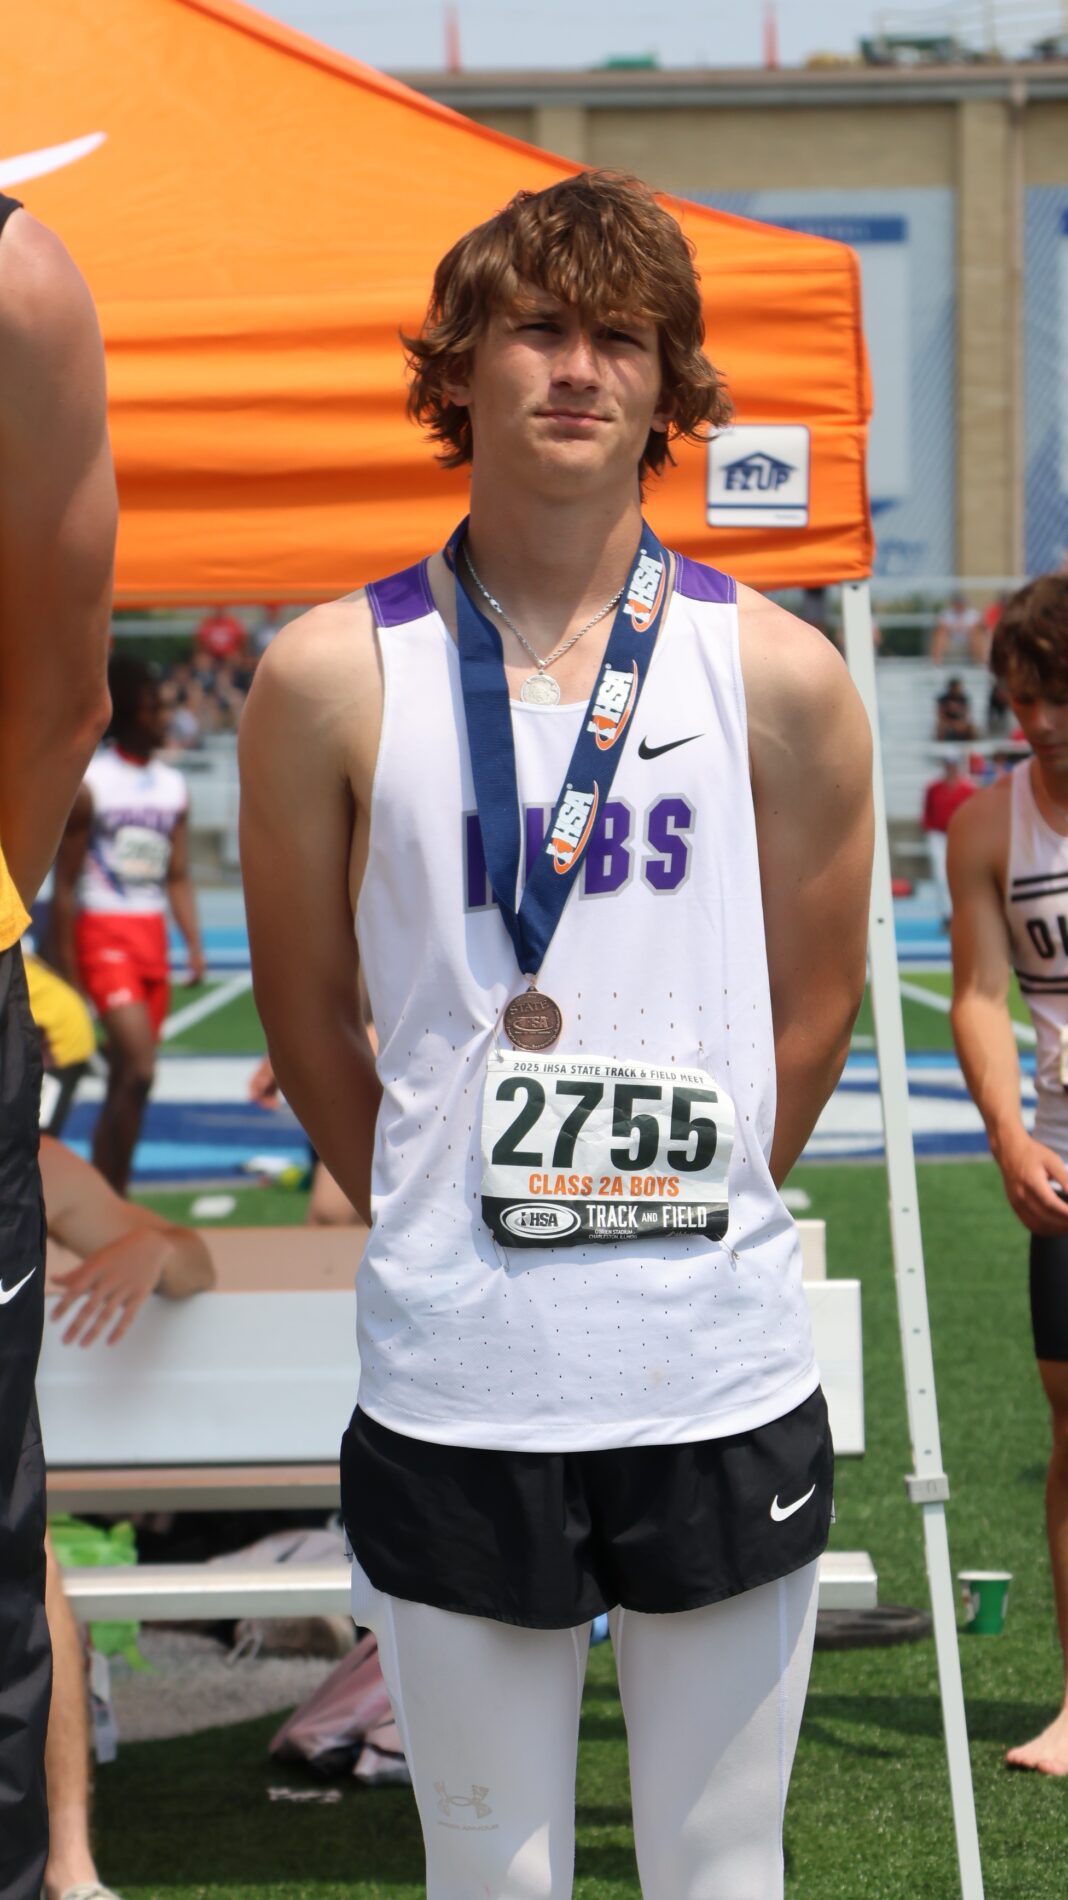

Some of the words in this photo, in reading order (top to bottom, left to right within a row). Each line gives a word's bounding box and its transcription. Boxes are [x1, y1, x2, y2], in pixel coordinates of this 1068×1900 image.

[510, 999, 550, 1016] STATE
[513, 1062, 539, 1073] 2025
[543, 1063, 567, 1074] IHSA
[571, 1065, 600, 1075] STATE
[605, 1067, 637, 1078] TRACK
[640, 1069, 647, 1078] &
[650, 1070, 677, 1081] FIELD
[680, 1074, 704, 1085] MEET
[491, 1076, 718, 1173] 2755
[529, 1173, 593, 1196] CLASS
[598, 1176, 623, 1196] 2A
[630, 1176, 680, 1197] BOYS
[520, 1211, 559, 1227] IHSA
[586, 1204, 639, 1228] TRACK
[641, 1212, 658, 1223] AND
[662, 1205, 707, 1228] FIELD
